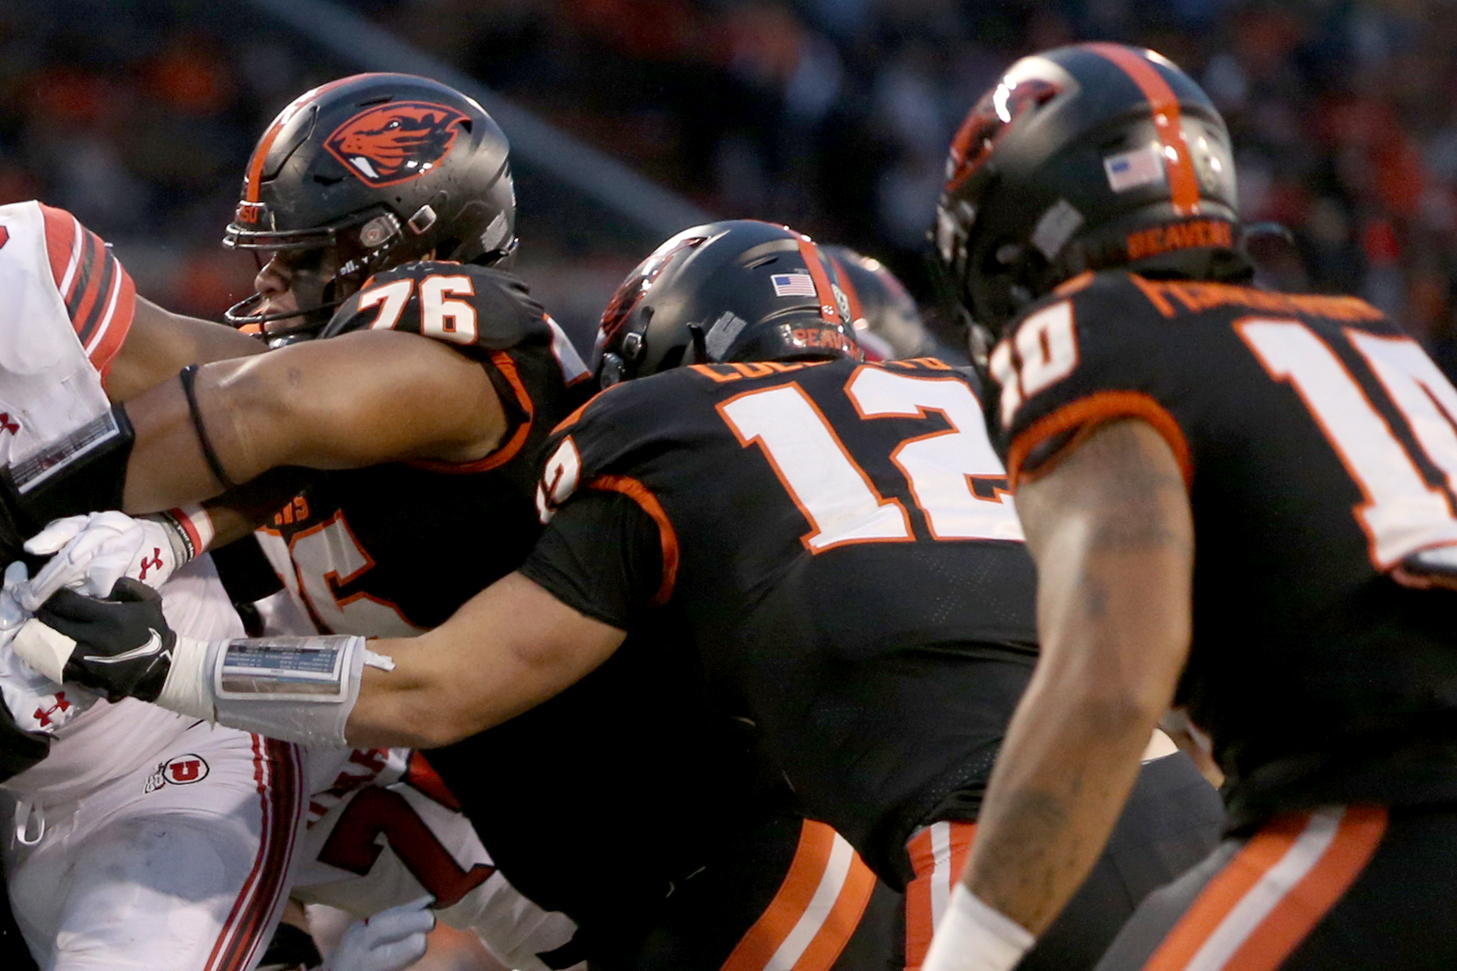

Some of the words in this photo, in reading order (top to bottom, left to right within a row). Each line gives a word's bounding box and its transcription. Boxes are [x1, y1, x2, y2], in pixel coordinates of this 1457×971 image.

[357, 274, 478, 346] 76
[987, 296, 1081, 432] 10
[715, 362, 1027, 556] 12
[169, 759, 201, 782] U
